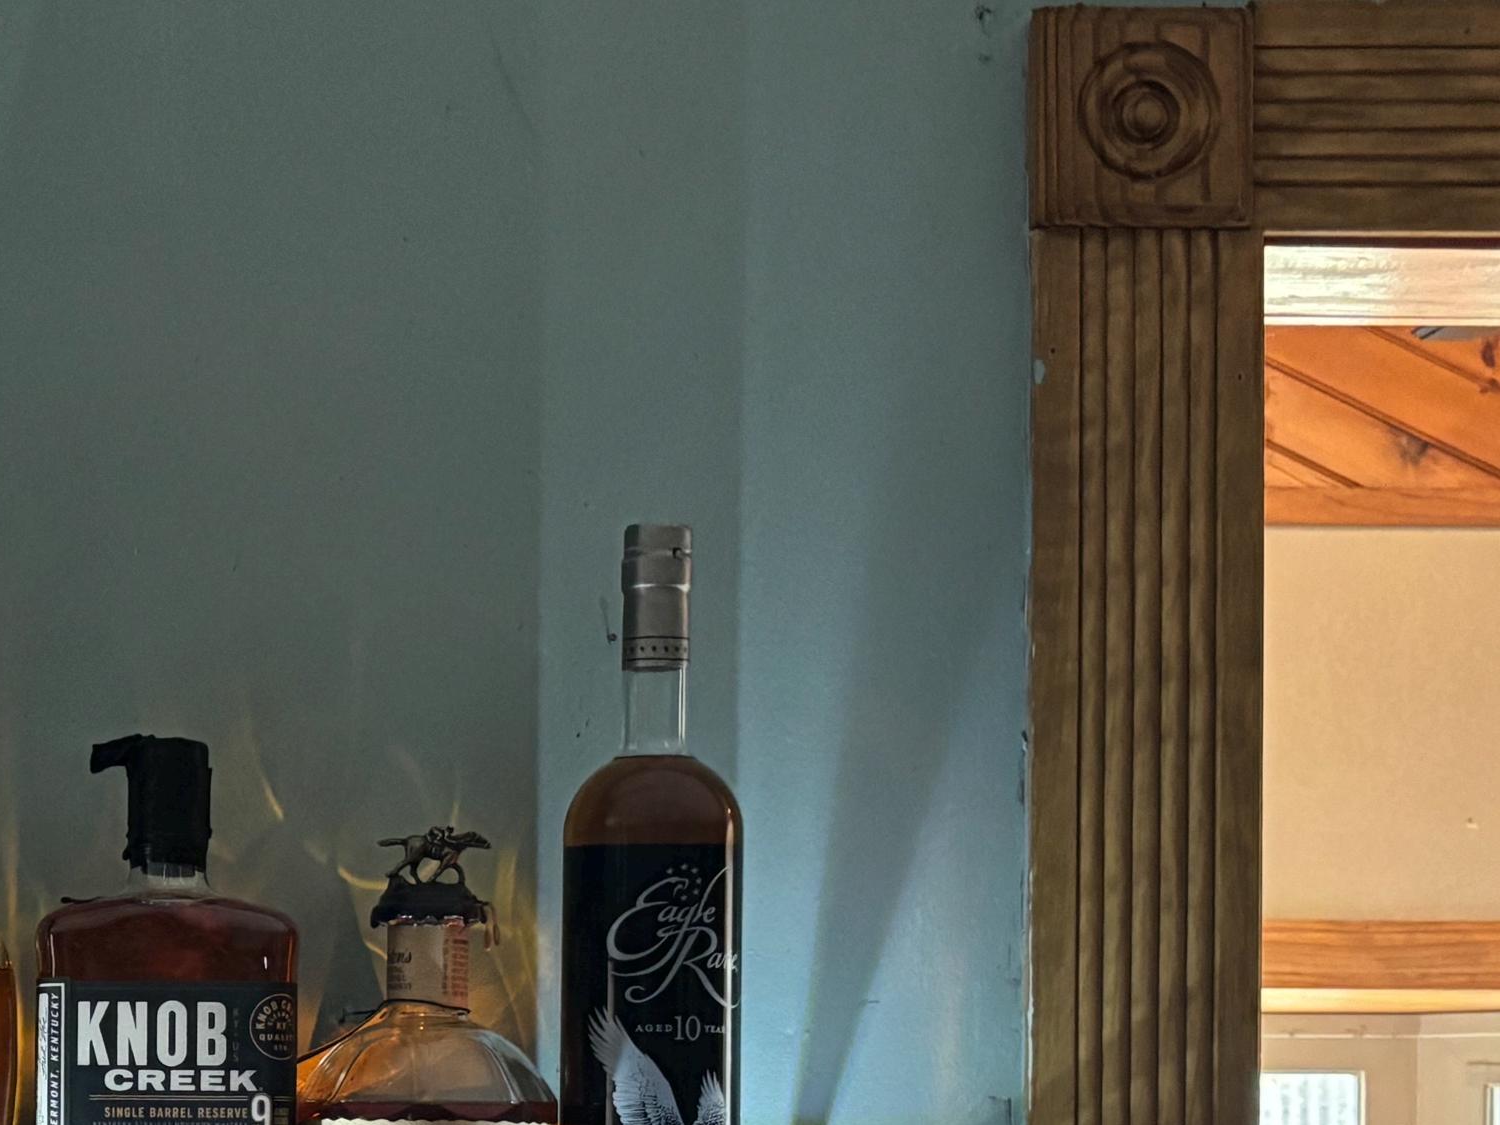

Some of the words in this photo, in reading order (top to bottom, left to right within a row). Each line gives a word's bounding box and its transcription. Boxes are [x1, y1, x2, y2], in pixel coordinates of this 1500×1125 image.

[606, 866, 730, 977] Eagle
[51, 992, 60, 1062] KENTUCKY
[76, 999, 228, 1067] KNOB
[634, 1024, 673, 1033] AGED
[674, 1015, 701, 1041] 10
[104, 1069, 258, 1092] CREEK
[104, 1106, 145, 1118] SINGLE
[150, 1107, 193, 1119] BARREL
[197, 1107, 248, 1119] RESERVE
